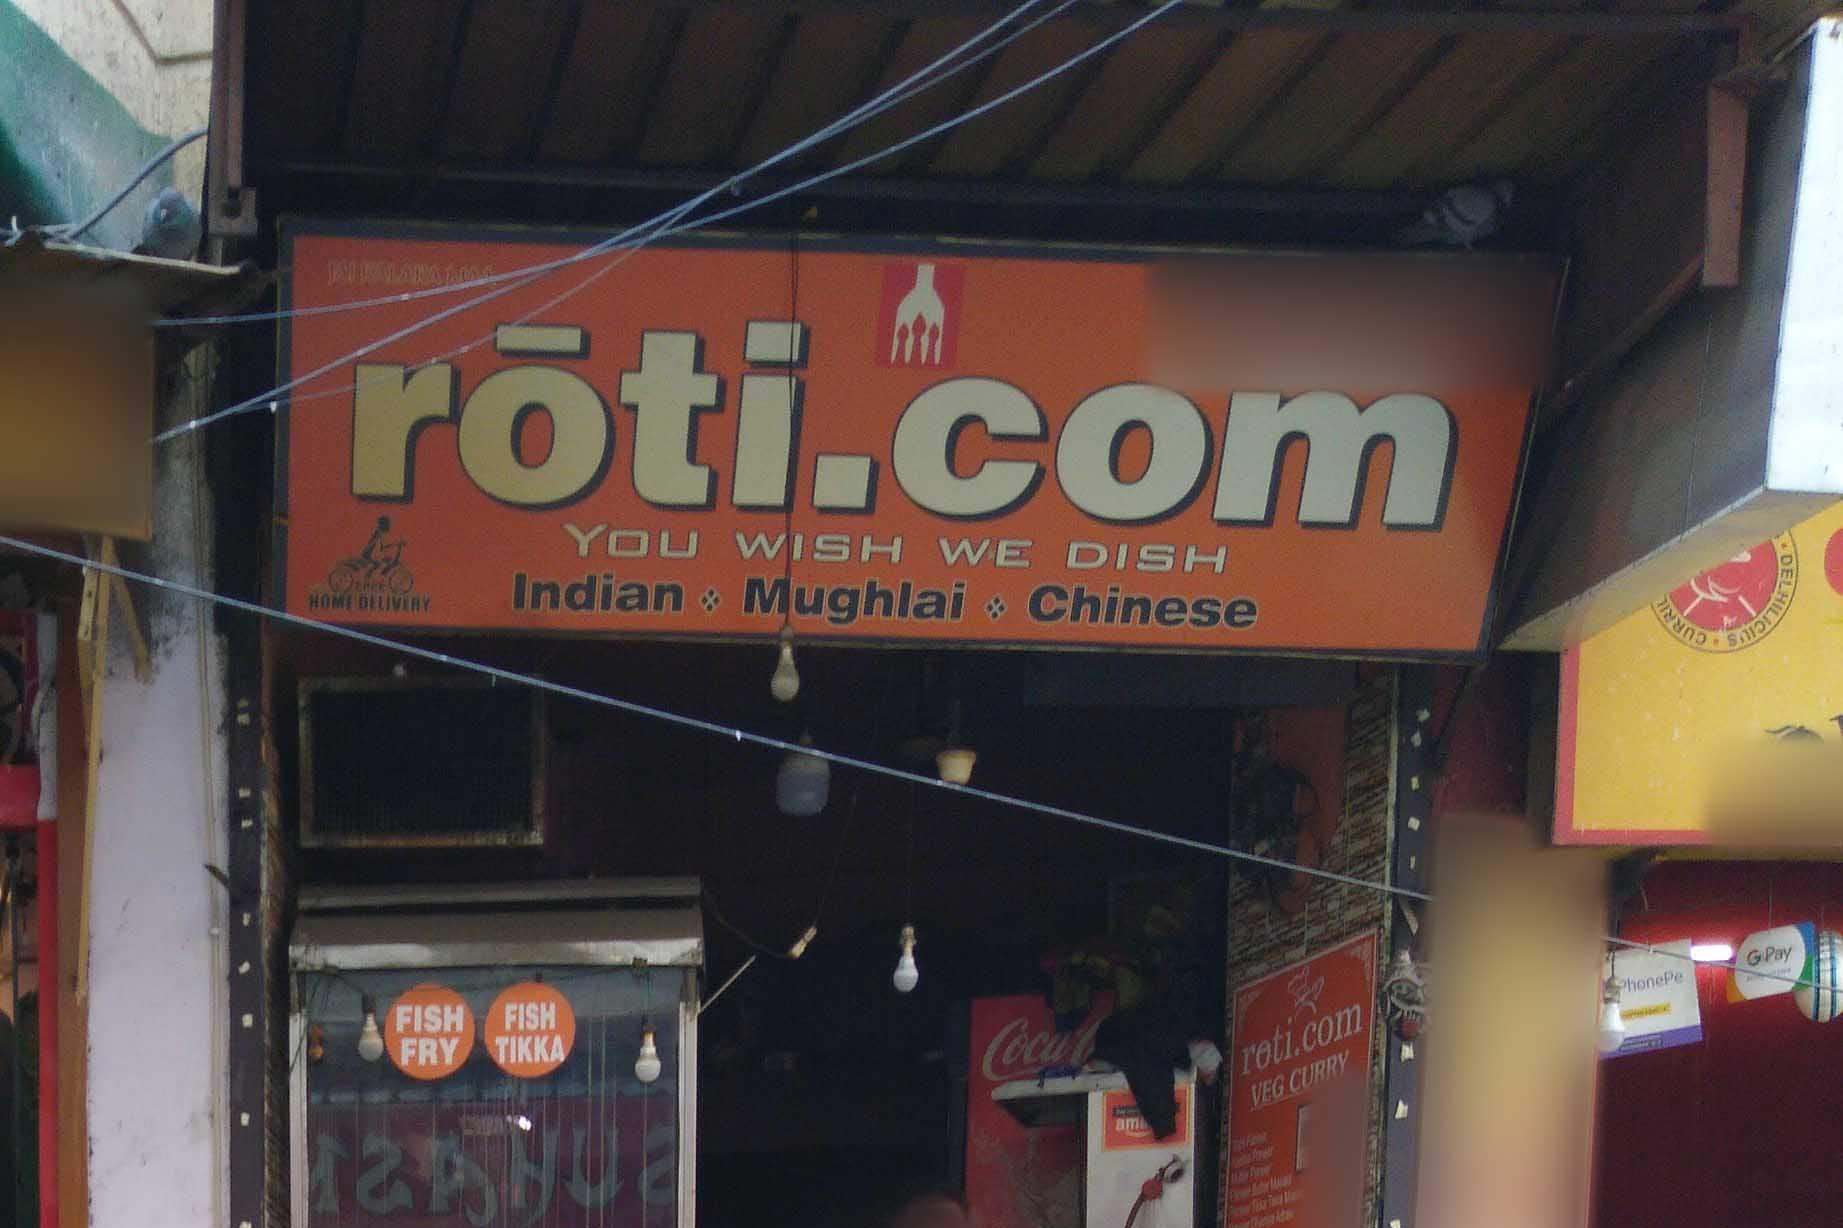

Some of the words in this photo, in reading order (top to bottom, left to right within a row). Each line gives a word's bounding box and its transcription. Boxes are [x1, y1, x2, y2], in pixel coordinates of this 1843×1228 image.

[563, 523, 699, 558] YOU
[735, 530, 902, 564] WISH
[940, 537, 1033, 568] WE
[1066, 543, 1228, 574] DISH
[309, 592, 352, 610] HOME
[359, 592, 431, 612] DELIVERY
[512, 572, 684, 612] Indian
[743, 577, 966, 625] Mughlai
[1028, 583, 1258, 630] Chinese
[396, 1005, 464, 1033] FISH
[504, 1003, 556, 1030] FISH
[401, 1038, 460, 1066] FRY
[496, 1036, 566, 1064] TIKKA
[1251, 1074, 1285, 1107] VEG
[1289, 1050, 1349, 1094] CURRY
